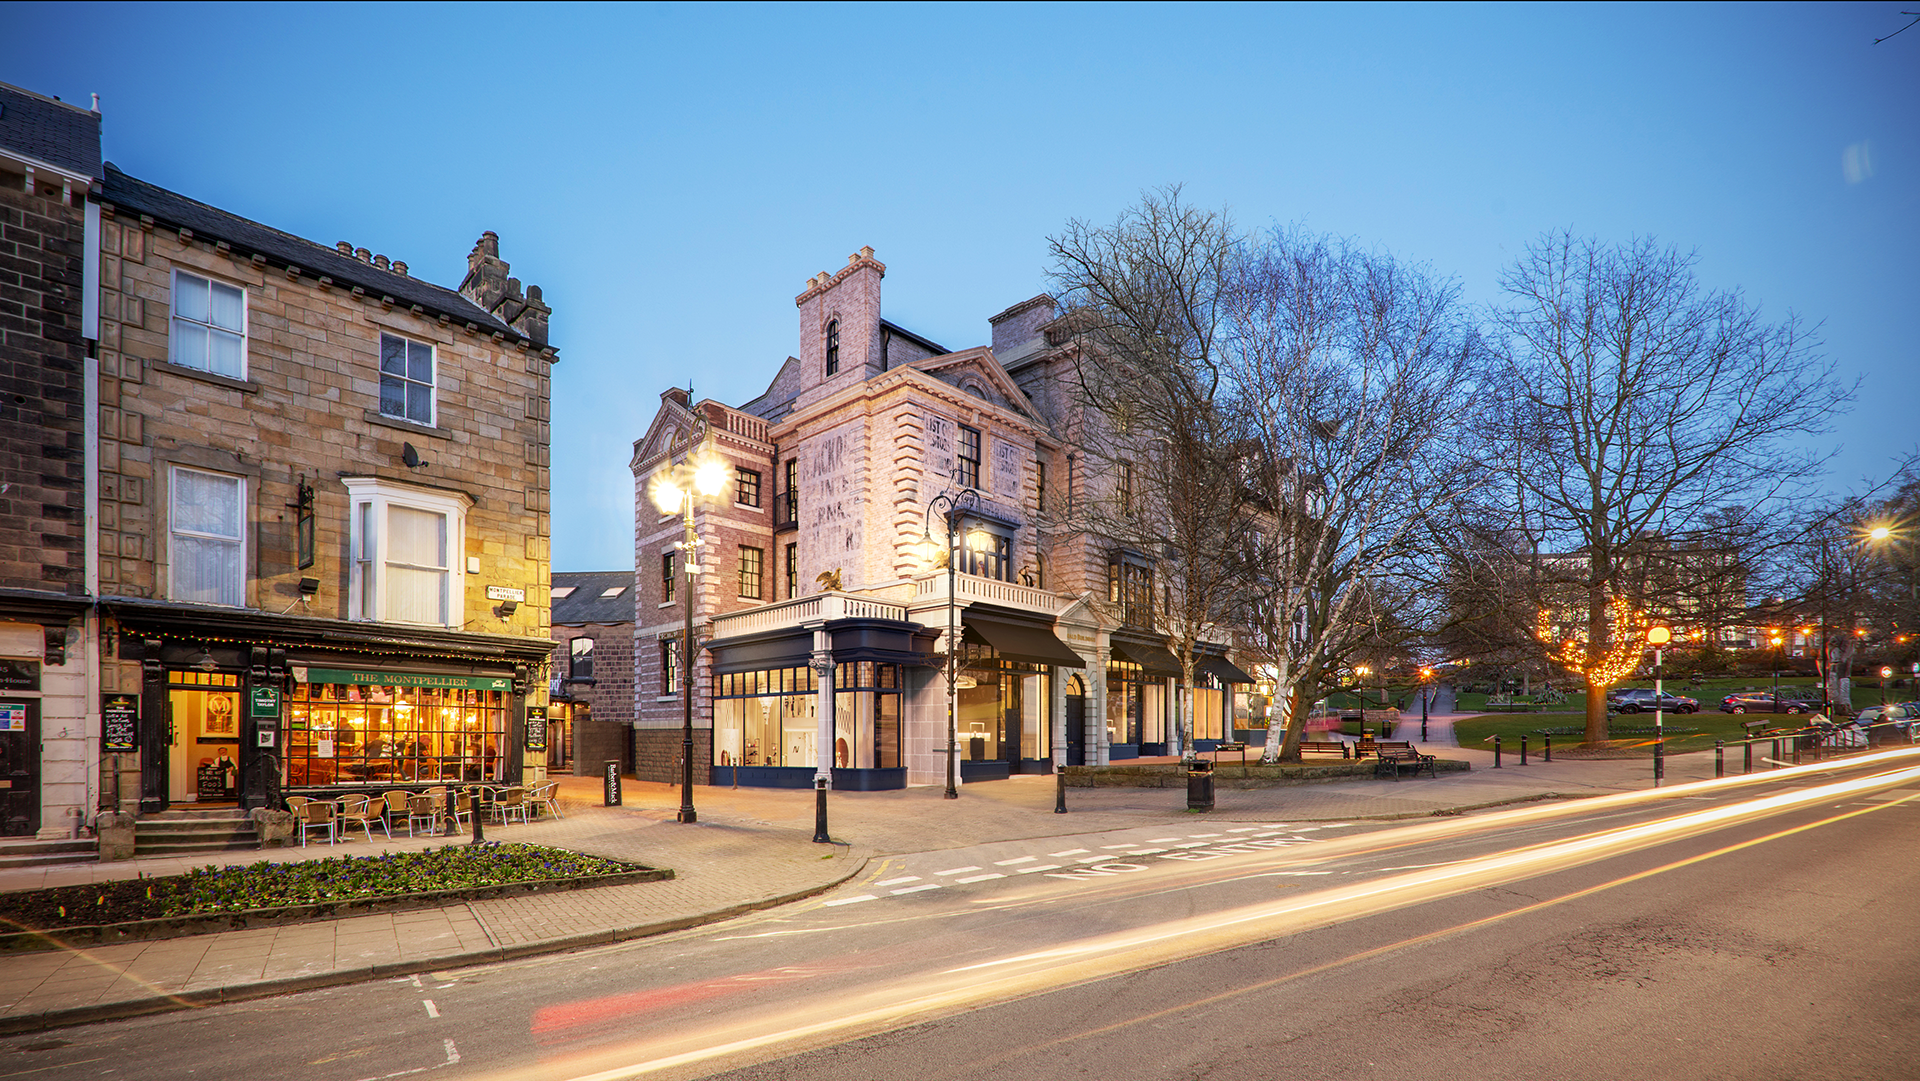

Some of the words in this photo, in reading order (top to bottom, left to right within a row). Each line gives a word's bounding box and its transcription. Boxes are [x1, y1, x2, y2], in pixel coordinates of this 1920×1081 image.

[489, 587, 523, 595] MONTPELLIER
[352, 673, 379, 683] THE
[384, 674, 469, 687] MONTPELLIER
[1043, 863, 1149, 881] NO
[1156, 836, 1326, 861] ENTRY
